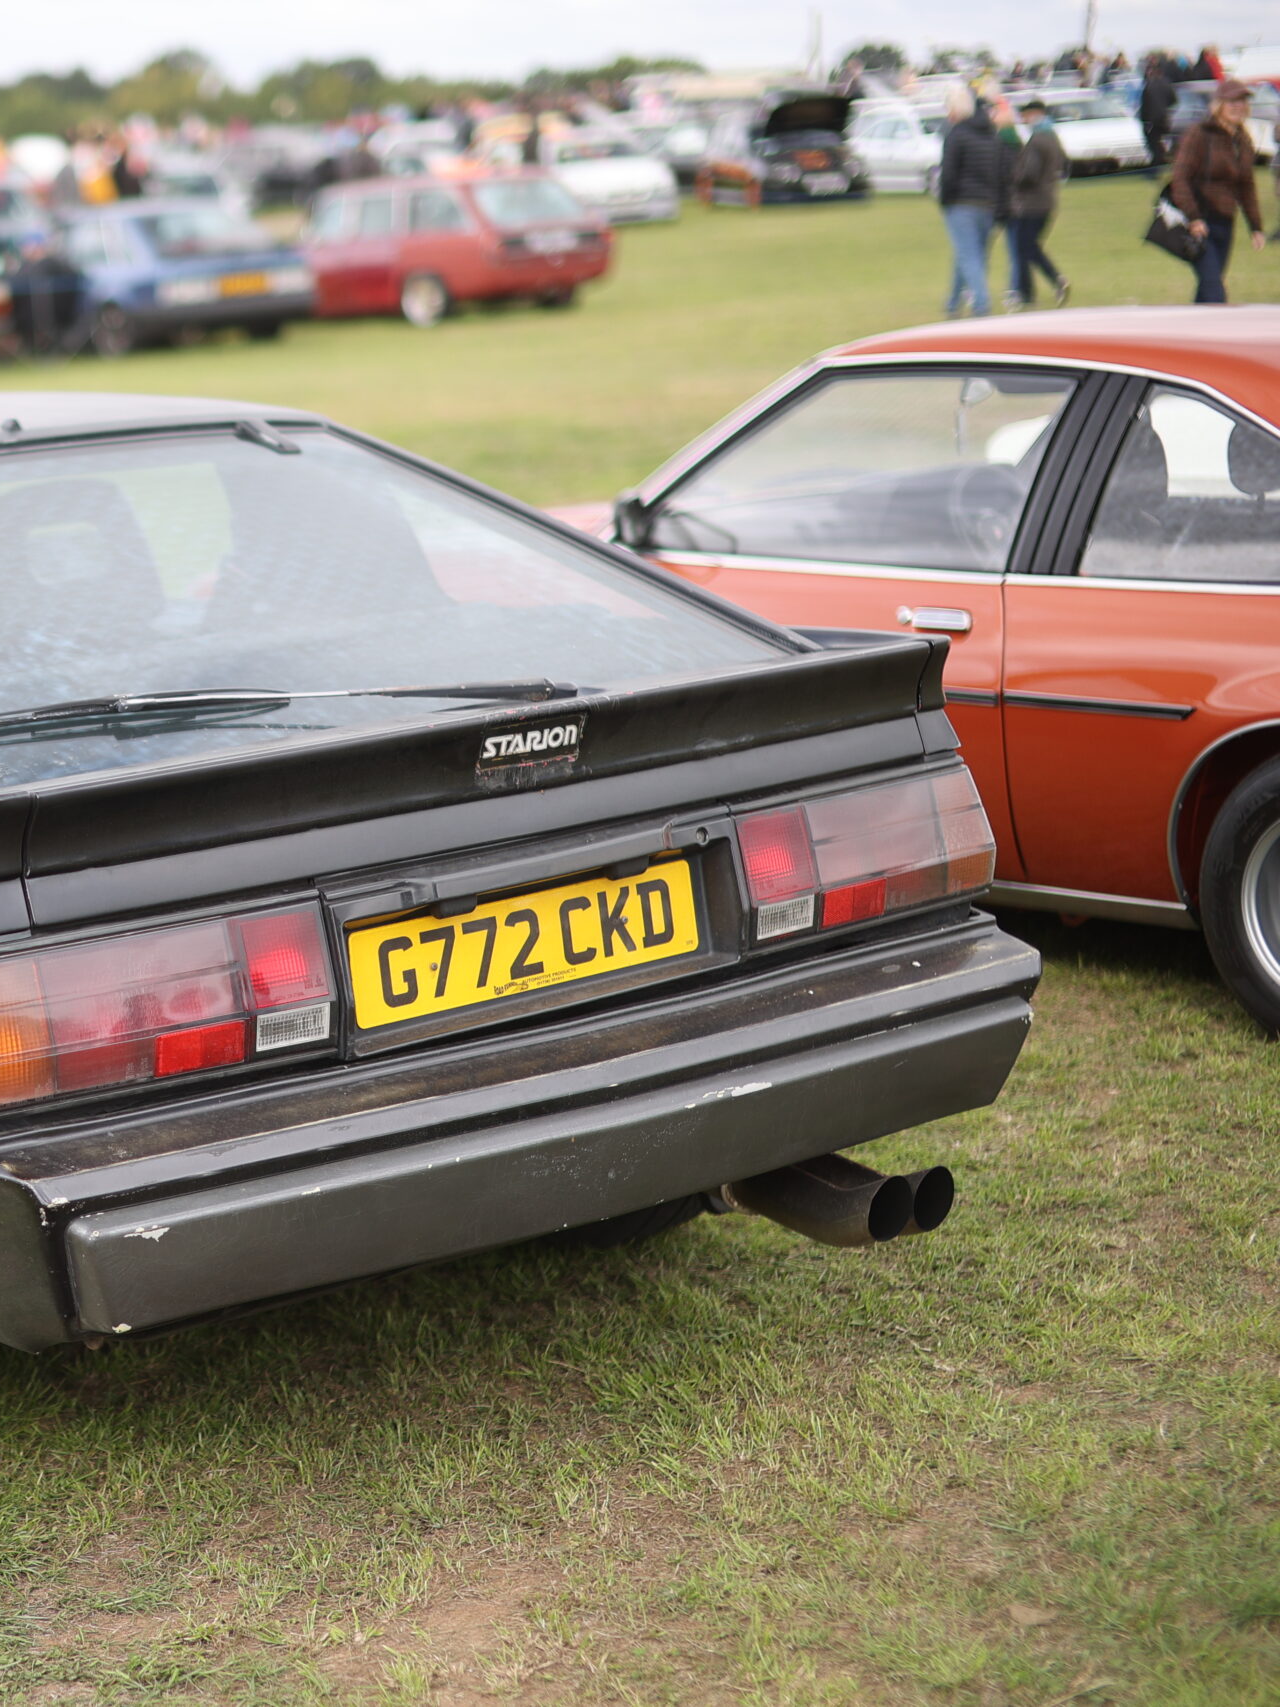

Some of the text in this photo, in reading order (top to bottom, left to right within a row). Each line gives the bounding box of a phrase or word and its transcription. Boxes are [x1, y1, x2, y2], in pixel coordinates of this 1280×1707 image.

[482, 724, 578, 759] STARION
[377, 879, 675, 1008] G772 CKD
